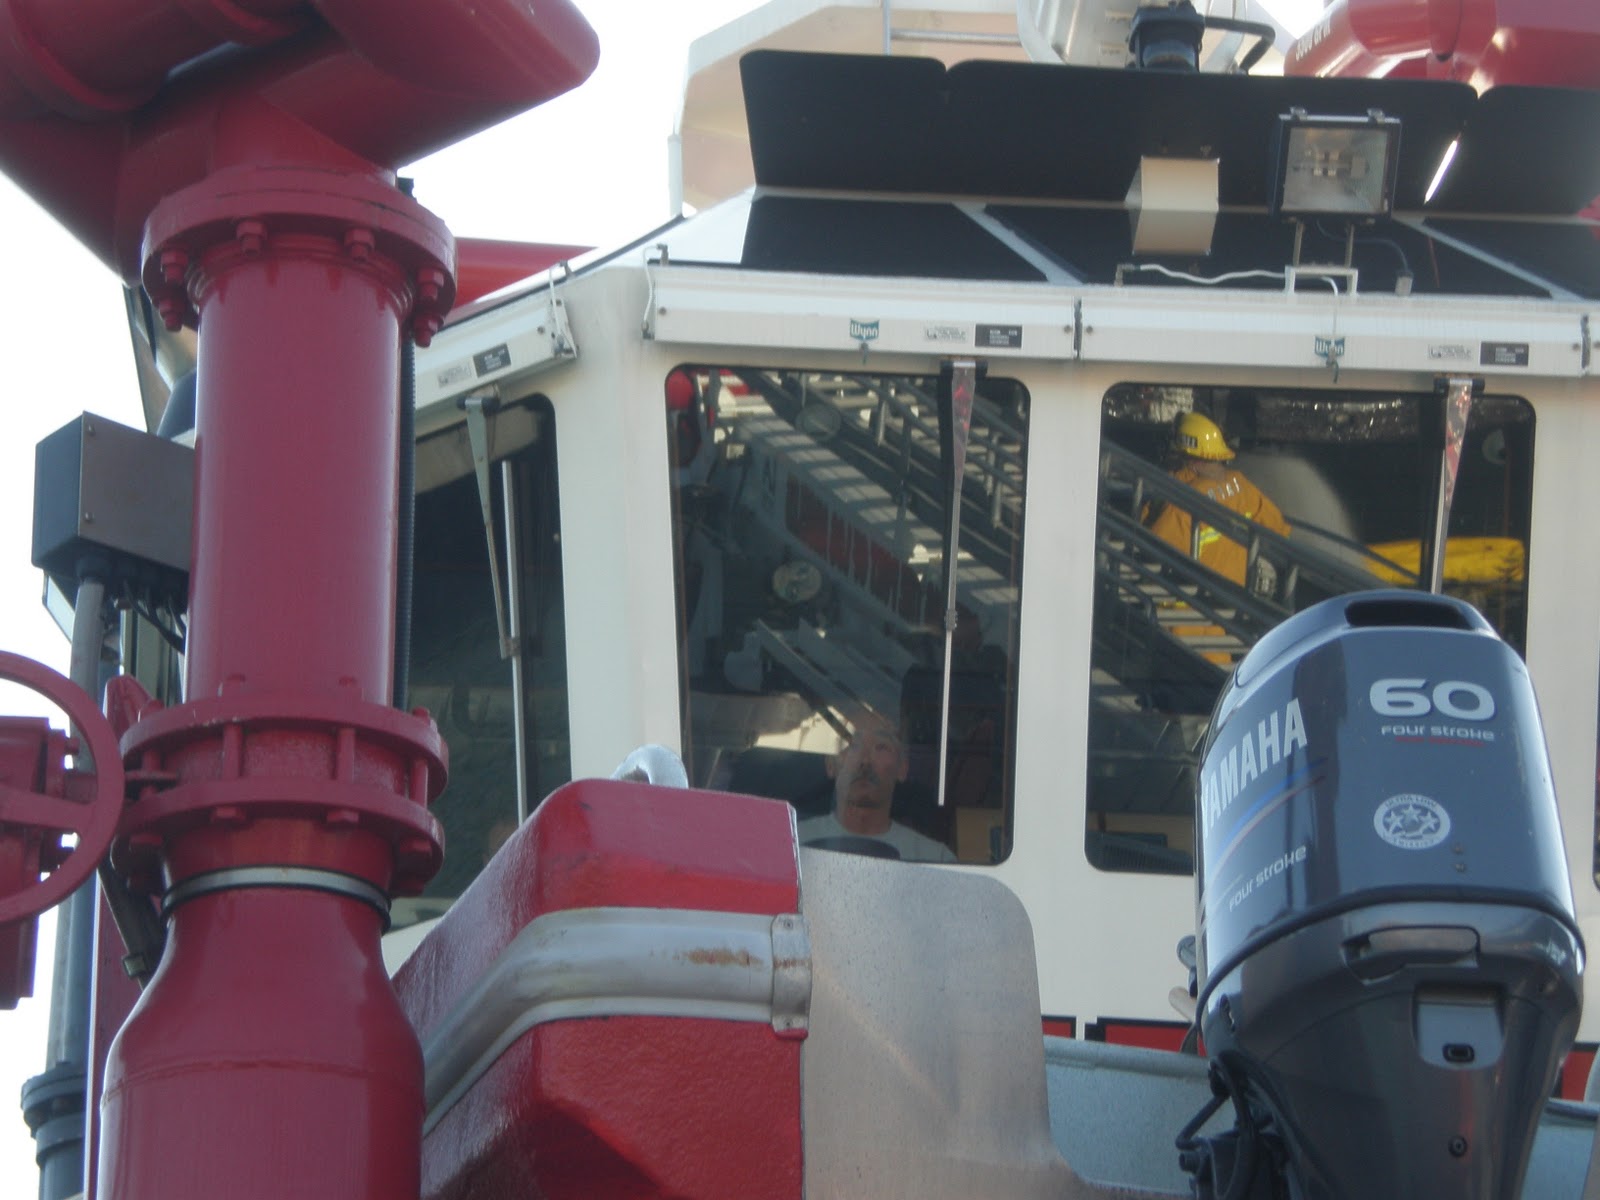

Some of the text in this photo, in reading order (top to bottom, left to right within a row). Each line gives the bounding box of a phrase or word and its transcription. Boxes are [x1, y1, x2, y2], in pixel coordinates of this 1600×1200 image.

[851, 322, 879, 341] Wynn
[1369, 678, 1495, 721] 60
[1200, 698, 1308, 840] YAMAHA
